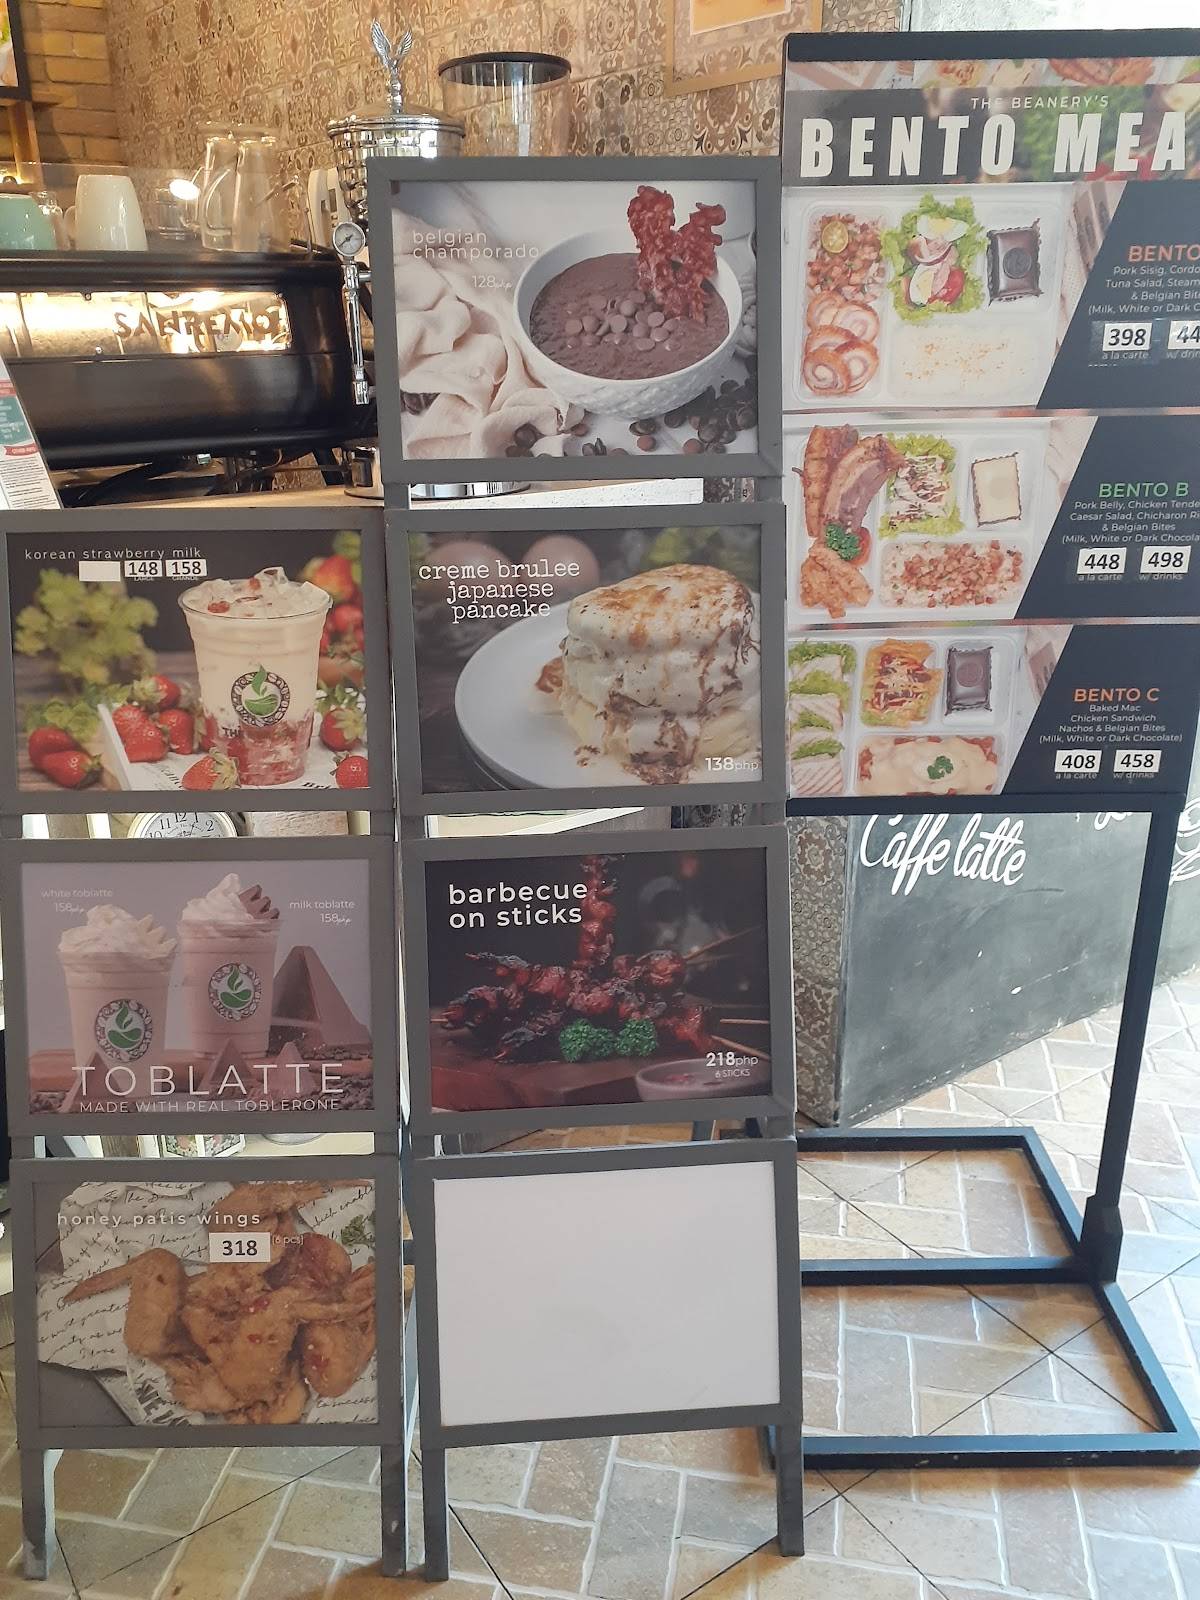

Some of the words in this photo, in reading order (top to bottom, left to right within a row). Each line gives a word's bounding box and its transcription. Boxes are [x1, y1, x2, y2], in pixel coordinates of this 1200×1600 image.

[971, 97, 1004, 110] THE
[1011, 95, 1110, 110] BEANERY'S
[800, 113, 1016, 178] BENTO
[1053, 111, 1186, 173] MEA
[412, 229, 487, 247] belgian
[413, 243, 539, 261] champorado
[1128, 244, 1200, 262] BENTO
[1113, 266, 1137, 275] Pork
[1105, 279, 1131, 288] Tuna
[1134, 278, 1165, 288] Salad,
[1131, 292, 1138, 300] &
[1141, 291, 1181, 301] Belgian
[1119, 303, 1151, 313] White
[1152, 305, 1162, 313] or
[1166, 303, 1191, 312] Dark
[1108, 328, 1147, 346] 398
[1102, 352, 1108, 360] a
[1110, 351, 1120, 360] la
[1122, 351, 1149, 359] carte
[1099, 482, 1169, 498] BENTO
[1175, 482, 1189, 497] B
[1074, 501, 1097, 510] Pork
[1100, 500, 1125, 511] Belly,
[1127, 500, 1168, 509] Chicken
[1069, 512, 1103, 521] Caesar
[1136, 510, 1187, 520] Chicharon
[1101, 523, 1109, 532] &
[1111, 523, 1149, 533] Belgian
[1151, 522, 1176, 531] Bites
[1090, 534, 1120, 543] White
[1135, 534, 1158, 542] Dark
[25, 549, 76, 560] korean
[82, 548, 165, 561] strawberry
[172, 547, 202, 558] milk
[1084, 553, 1121, 570] 448
[1148, 552, 1184, 568] 498
[128, 561, 158, 576] 148
[171, 561, 202, 575] 158
[418, 563, 491, 580] creme
[495, 558, 581, 578] brulee
[446, 580, 554, 604] japanese
[450, 599, 551, 624] pancake
[1073, 687, 1141, 702] BENTO
[1146, 687, 1160, 701] C
[1089, 704, 1119, 712] Baked
[1121, 703, 1141, 712] Mac
[1070, 714, 1109, 722] Chicken
[1111, 714, 1157, 722] Sandwich
[1058, 724, 1094, 733] Nachos
[1096, 724, 1103, 732] &
[1104, 723, 1140, 733] Belgian
[1142, 723, 1166, 732] Bites
[1066, 734, 1095, 743] White
[1108, 734, 1131, 742] Dark
[1133, 734, 1183, 743] Chocolate)
[1061, 754, 1096, 769] 408
[1120, 753, 1155, 768] 458
[160, 818, 171, 830] 11
[205, 820, 215, 832] 2
[859, 813, 951, 896] Caffe
[953, 813, 1027, 887] latte
[41, 888, 71, 898] white
[73, 888, 113, 898] toblatte
[449, 882, 588, 905] barbecue
[289, 899, 312, 909] milk
[314, 899, 356, 909] toblatte
[449, 911, 485, 929] on
[496, 903, 582, 927] sticks
[71, 1063, 344, 1096] TOBLATTE
[715, 1070, 721, 1079] 6
[722, 1068, 751, 1078] STICKS
[80, 1101, 129, 1113] MADE
[135, 1100, 179, 1113] WITH
[186, 1100, 228, 1112] REAL
[234, 1099, 339, 1112] TOBLERONE
[57, 1212, 122, 1228] honey
[133, 1211, 187, 1227] patis
[196, 1211, 261, 1227] wings
[222, 1239, 258, 1257] 318
